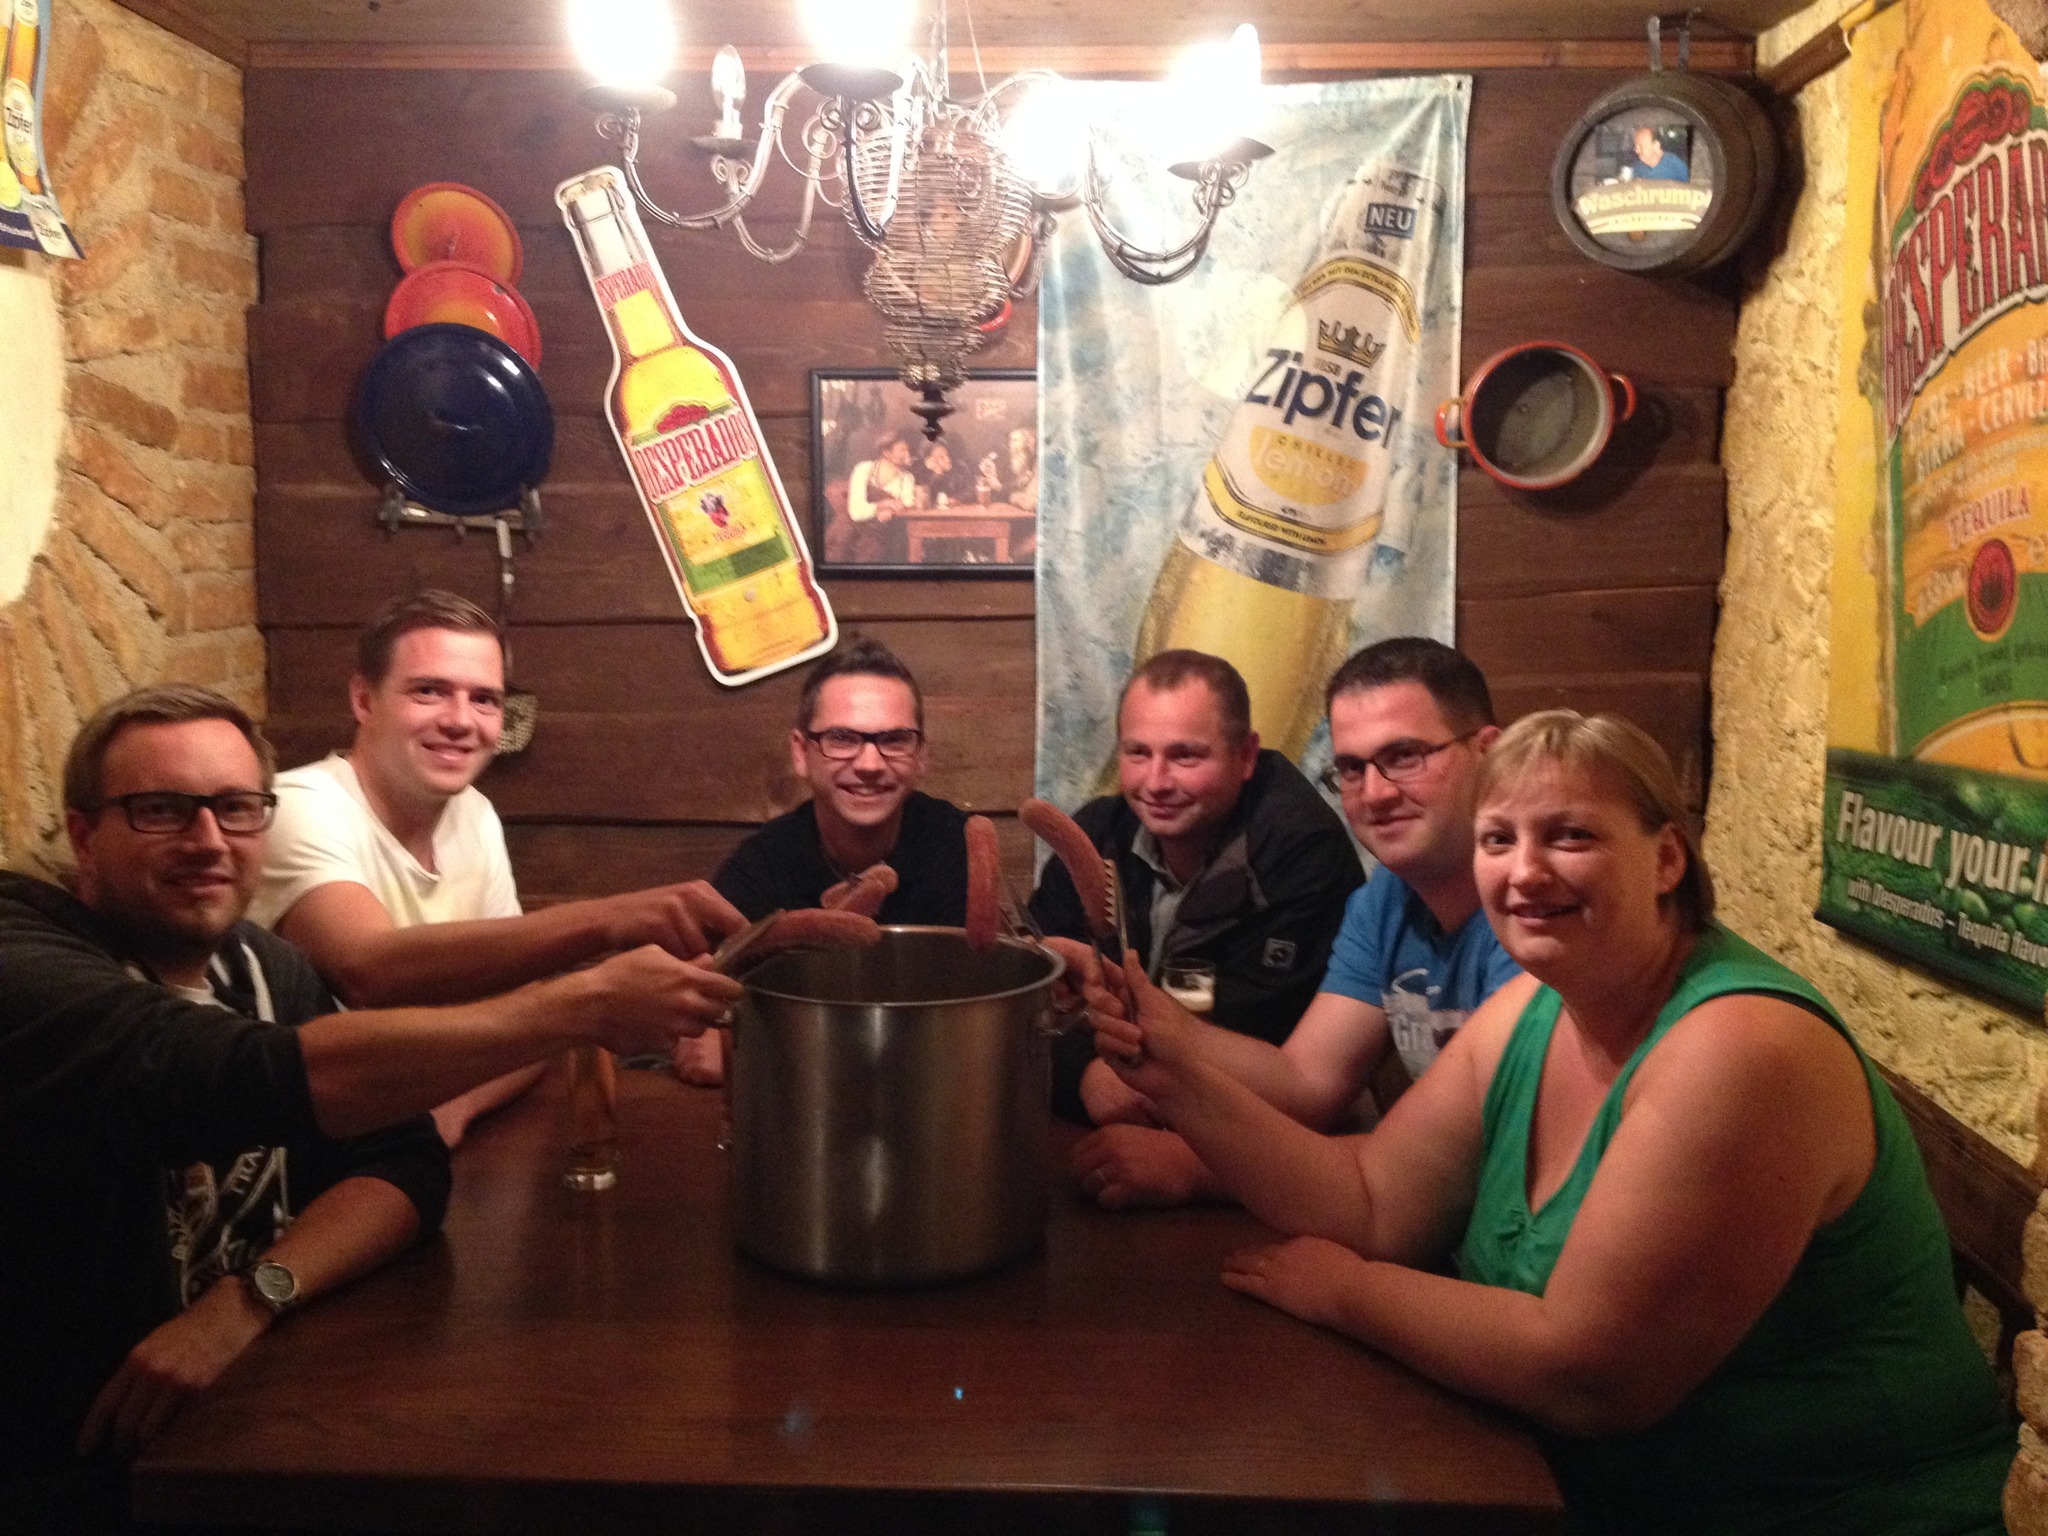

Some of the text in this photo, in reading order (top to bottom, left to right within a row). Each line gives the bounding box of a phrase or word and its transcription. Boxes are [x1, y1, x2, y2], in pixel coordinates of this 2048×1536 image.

[1369, 205, 1413, 230] NEU
[1245, 347, 1402, 450] Zipfer
[632, 409, 758, 501] DESPERADOS
[1949, 486, 2031, 549] TEQUILA
[1836, 790, 1944, 869] Flavour
[1944, 829, 2032, 895] your
[1848, 876, 1873, 904] with
[1872, 882, 1945, 930] Desperados
[1957, 911, 2011, 952] Tequila
